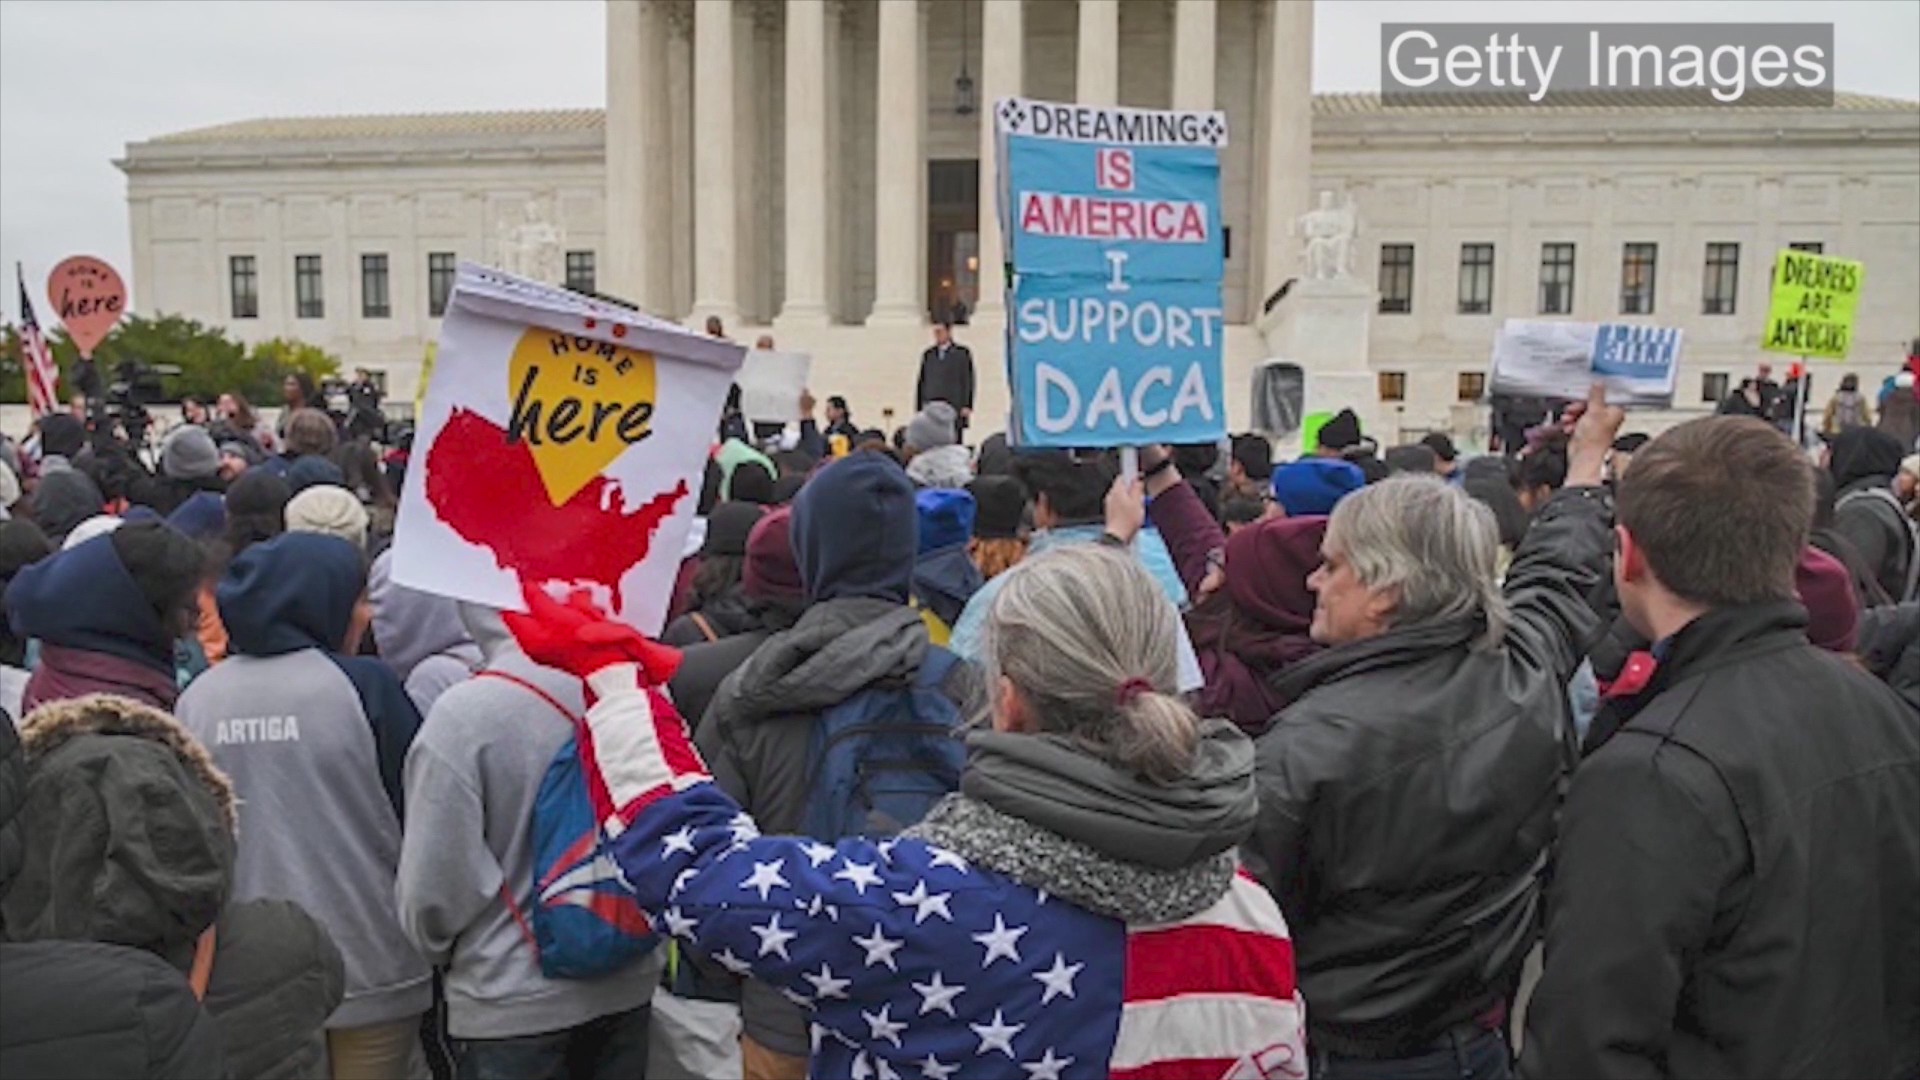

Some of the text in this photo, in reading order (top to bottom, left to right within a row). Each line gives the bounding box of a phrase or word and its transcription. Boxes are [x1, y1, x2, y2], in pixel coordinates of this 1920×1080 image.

[1031, 104, 1199, 142] DREAMING
[1097, 150, 1132, 189] IS
[1022, 195, 1205, 240] AMERICA
[1105, 250, 1130, 291] I
[61, 287, 121, 319] here
[1019, 298, 1222, 348] SUPPORT
[1798, 291, 1833, 319] ARE
[550, 333, 634, 376] HOME
[573, 363, 599, 386] IS
[507, 365, 653, 445] here
[1035, 361, 1214, 432] DACA
[217, 715, 300, 744] ARTIGA
